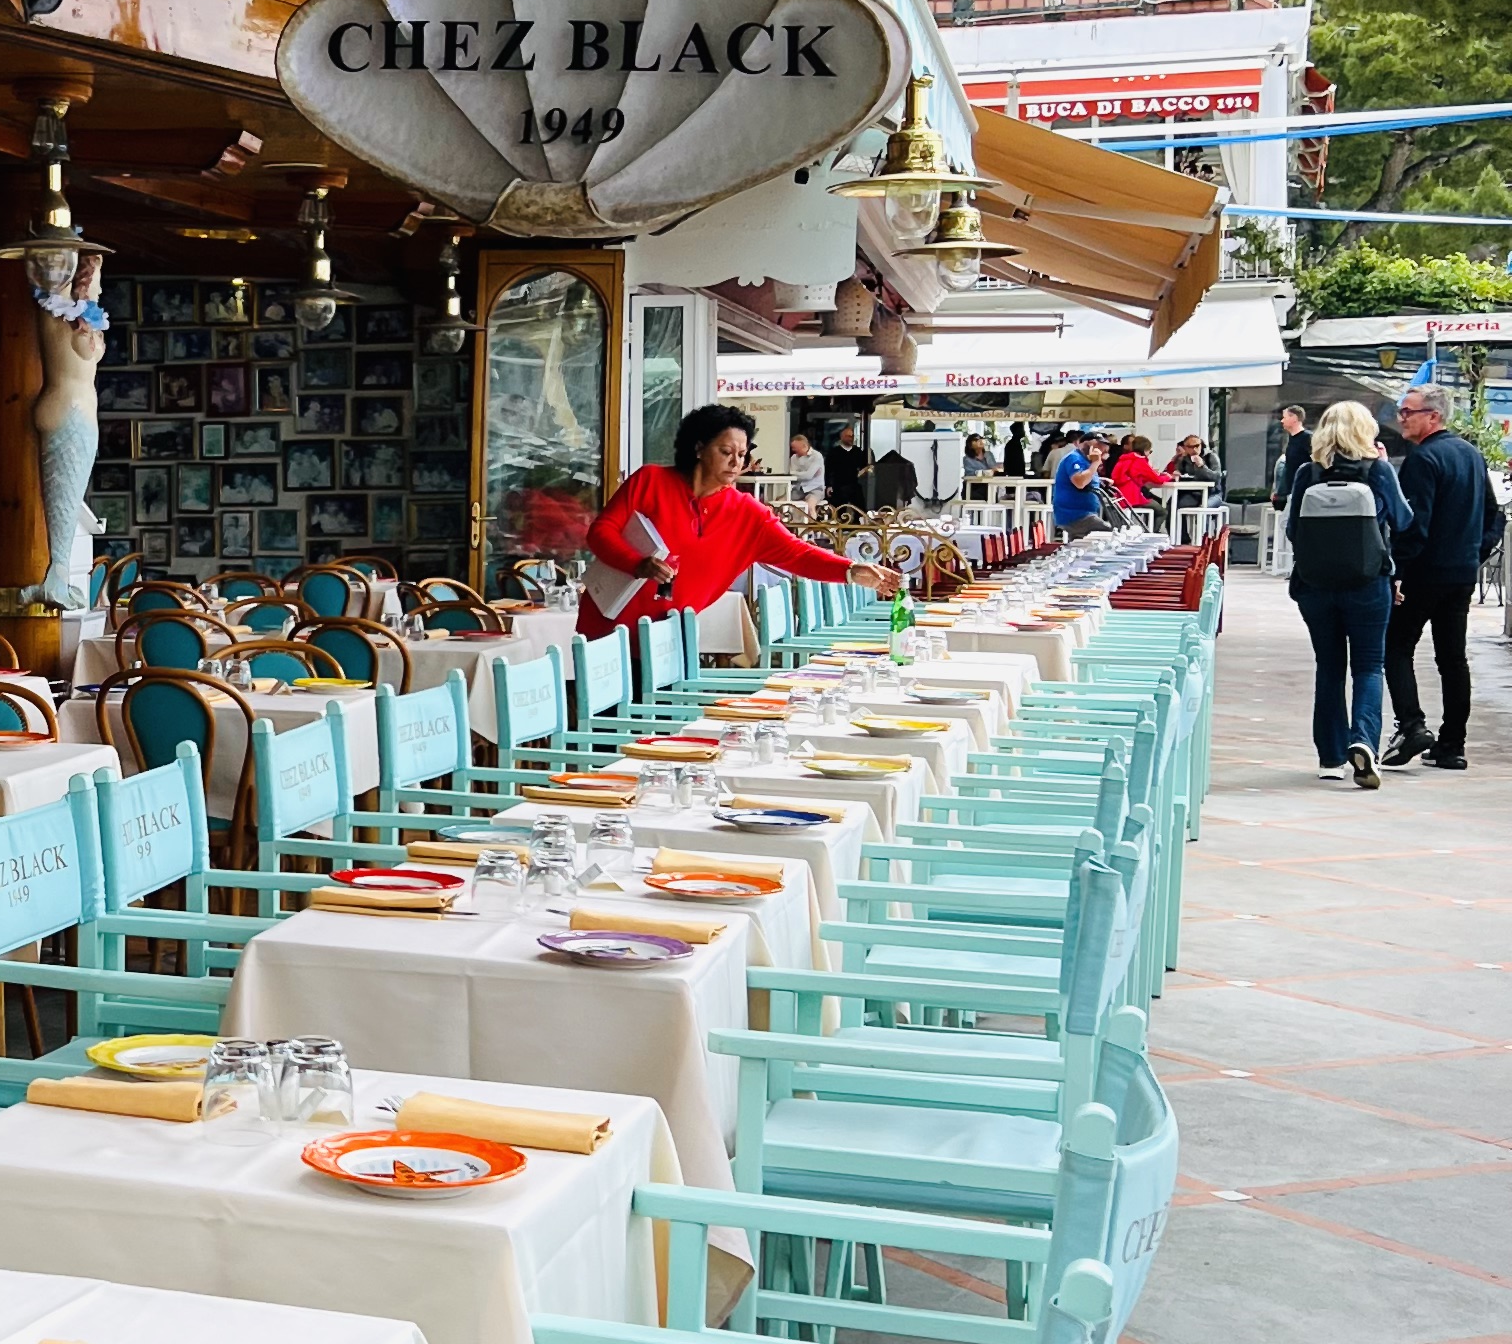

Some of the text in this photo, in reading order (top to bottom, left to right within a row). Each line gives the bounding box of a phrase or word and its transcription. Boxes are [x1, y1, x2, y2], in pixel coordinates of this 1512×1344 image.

[327, 19, 837, 78] CHEZ BLACK
[1025, 95, 1252, 118] BUCA DI BACCO 1916
[520, 106, 626, 146] 1949
[1426, 319, 1500, 332] Pizzeria
[717, 377, 805, 391] Pasticceria
[821, 375, 898, 390] Gelateria
[945, 372, 1029, 387] Ristorante
[1035, 371, 1053, 385] La
[1140, 395, 1194, 407] La Pergola
[1141, 407, 1194, 417] Ristorante
[8, 843, 69, 884] BLACK
